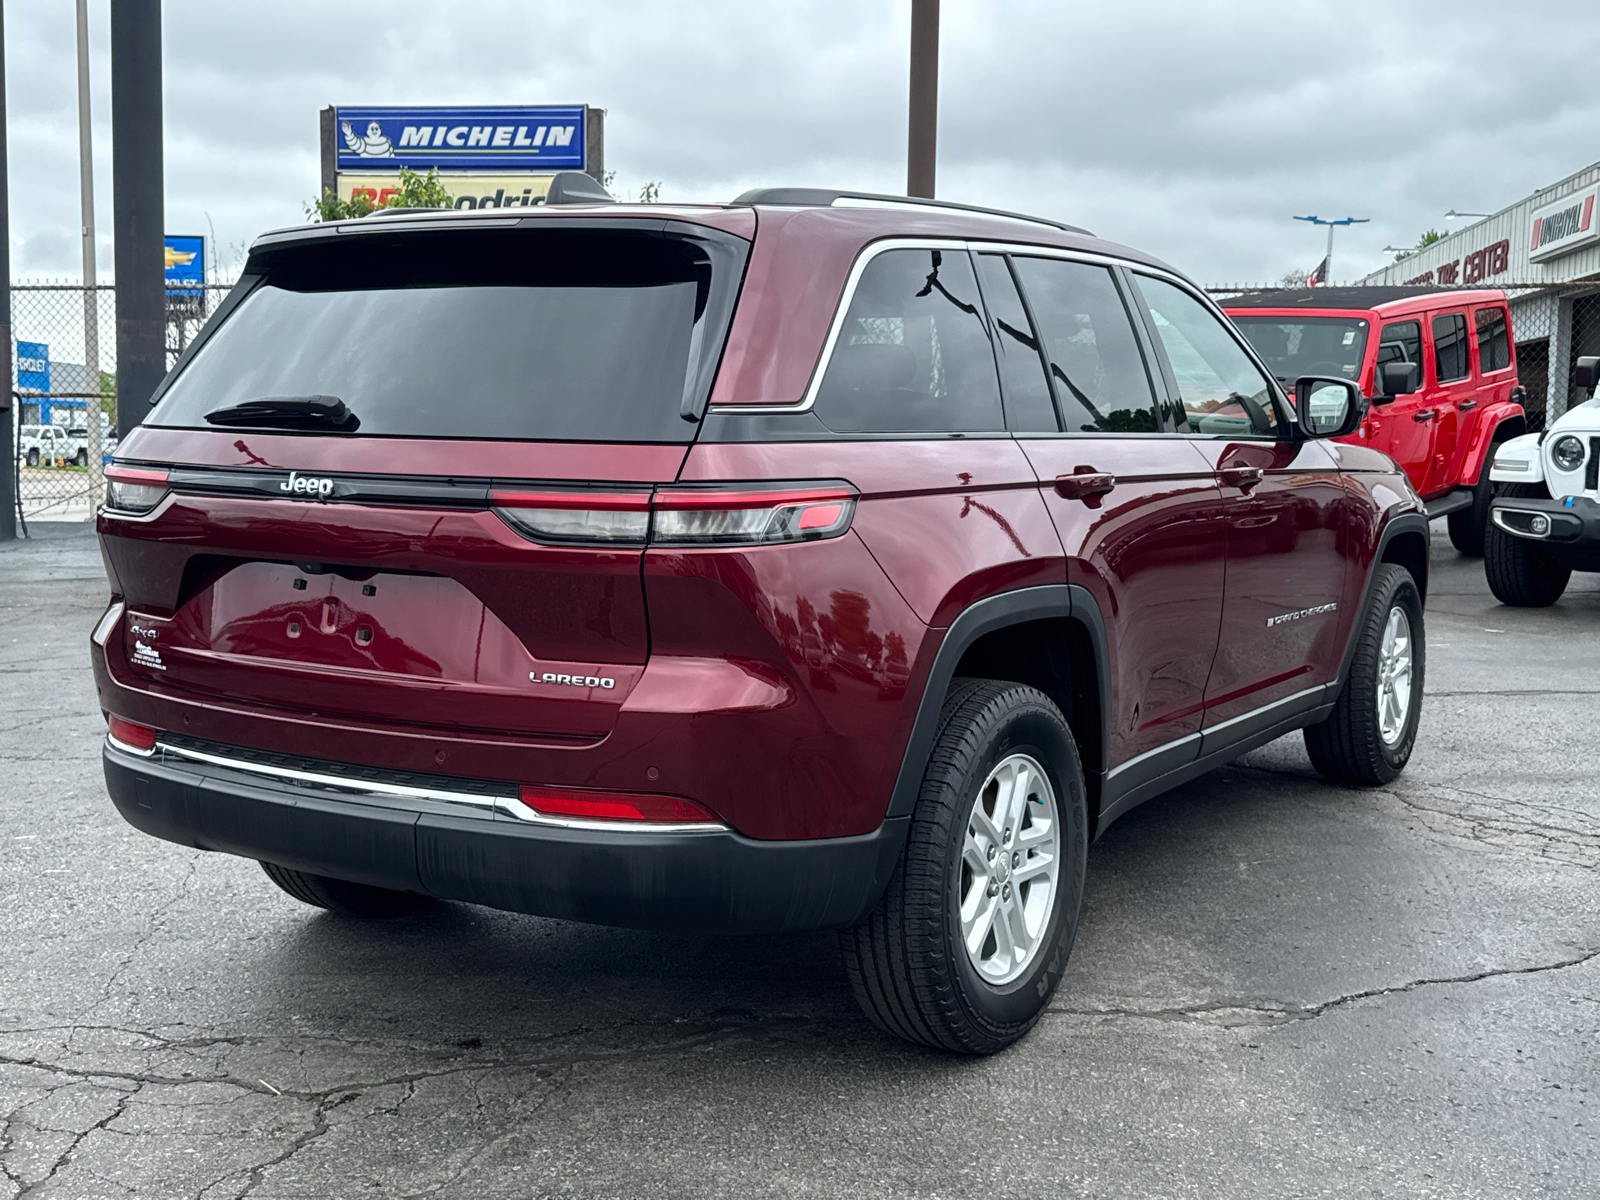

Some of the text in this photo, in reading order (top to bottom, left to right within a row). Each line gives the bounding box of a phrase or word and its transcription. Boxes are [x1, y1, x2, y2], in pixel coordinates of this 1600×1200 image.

[398, 125, 576, 147] MICHELIN
[1539, 202, 1583, 248] UNIROYAL
[1462, 238, 1510, 285] CENTER
[280, 471, 334, 499] Jeep
[528, 671, 616, 689] LAREDO
